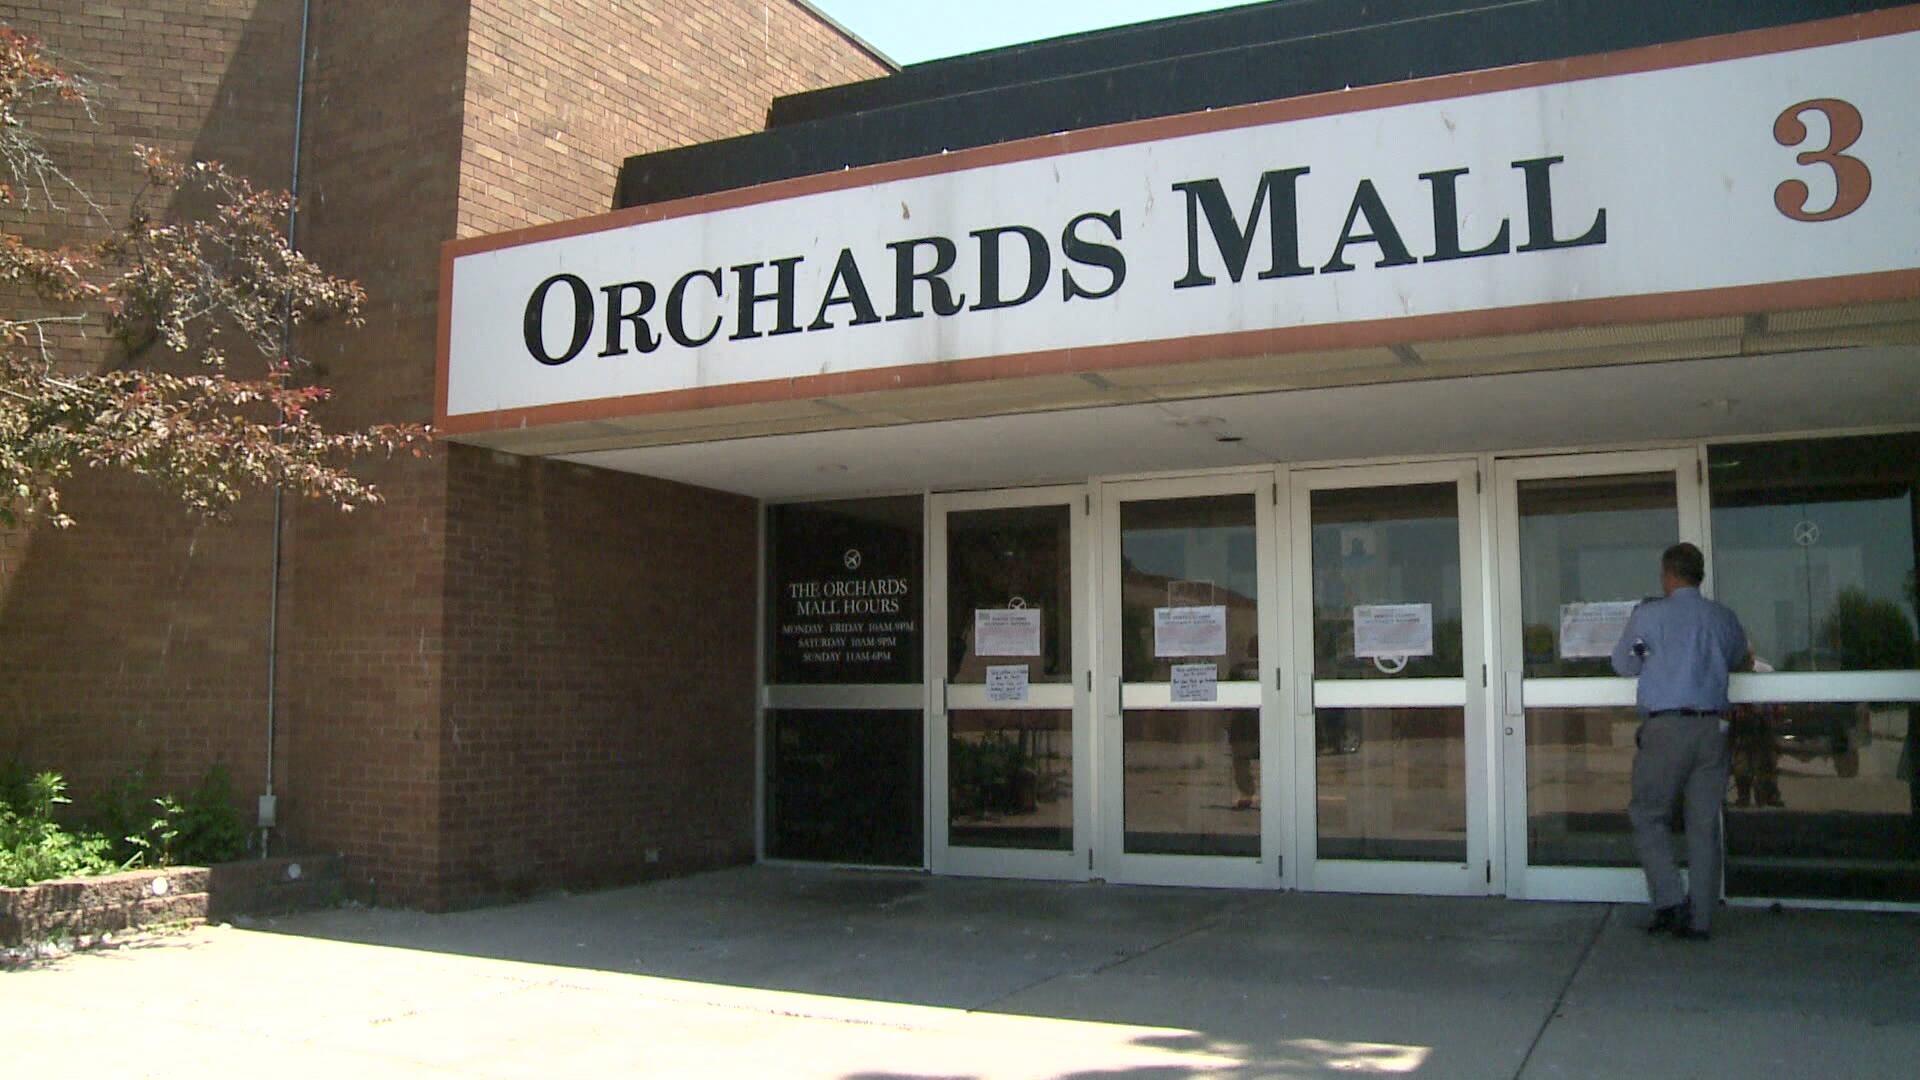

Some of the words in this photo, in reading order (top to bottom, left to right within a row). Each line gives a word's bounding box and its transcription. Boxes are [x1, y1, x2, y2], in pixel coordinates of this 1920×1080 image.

[523, 208, 1127, 367] ORCHARDS
[1171, 155, 1607, 290] MALL
[1773, 97, 1873, 223] 3
[789, 582, 820, 598] THE
[823, 578, 908, 598] ORCHARDS
[797, 600, 840, 616] MALL
[844, 598, 900, 614] HOURS
[782, 623, 824, 635] MONDAY
[829, 622, 864, 633] FRIDAY
[797, 637, 846, 649] SATURDAY
[802, 651, 841, 663] SUNDAY
